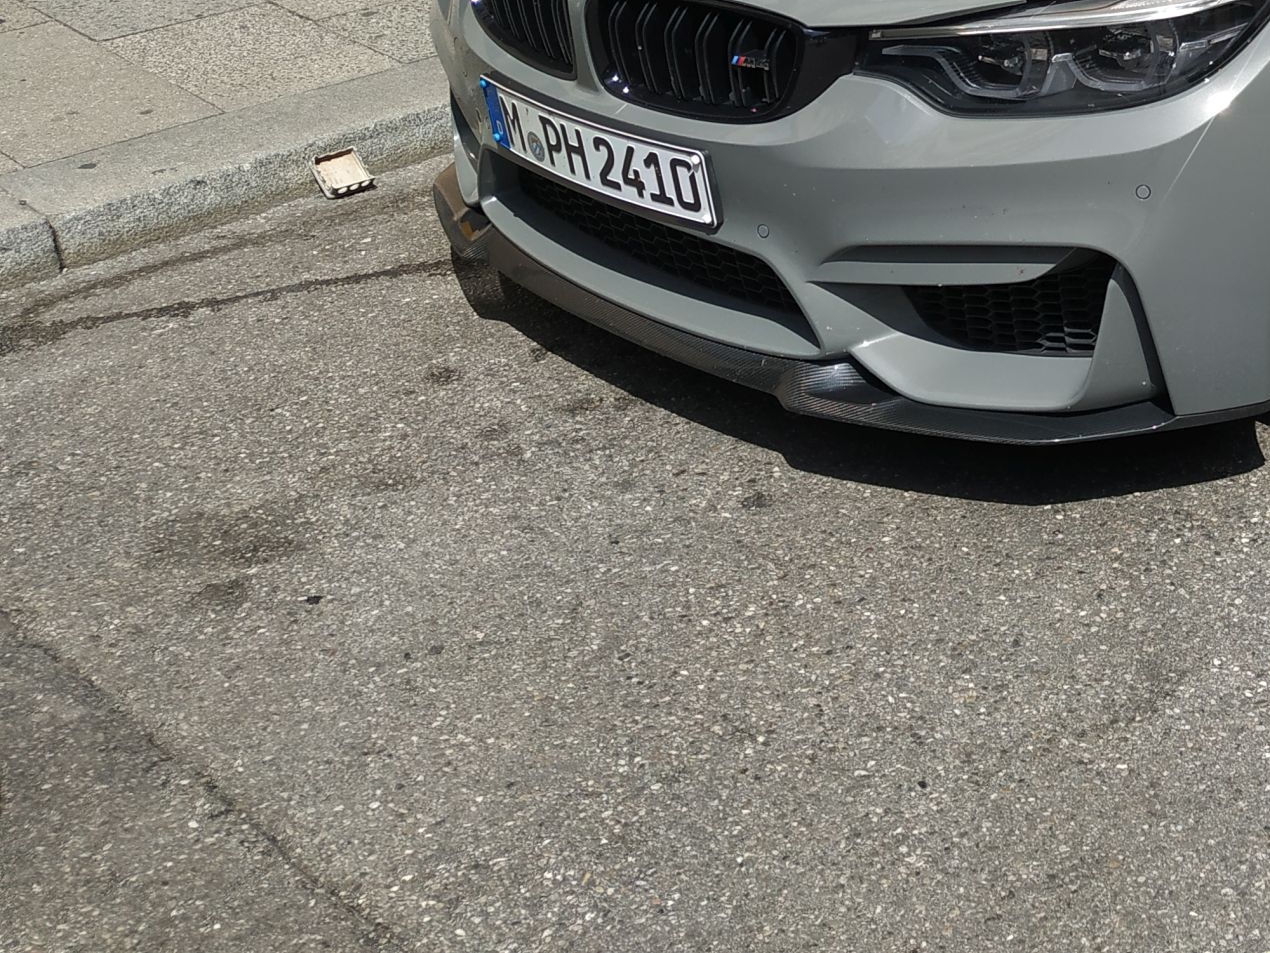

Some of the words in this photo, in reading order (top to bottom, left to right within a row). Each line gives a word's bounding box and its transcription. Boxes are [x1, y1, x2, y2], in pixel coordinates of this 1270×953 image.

[499, 95, 528, 154] M
[538, 114, 592, 181] PH
[592, 135, 703, 213] 2410
